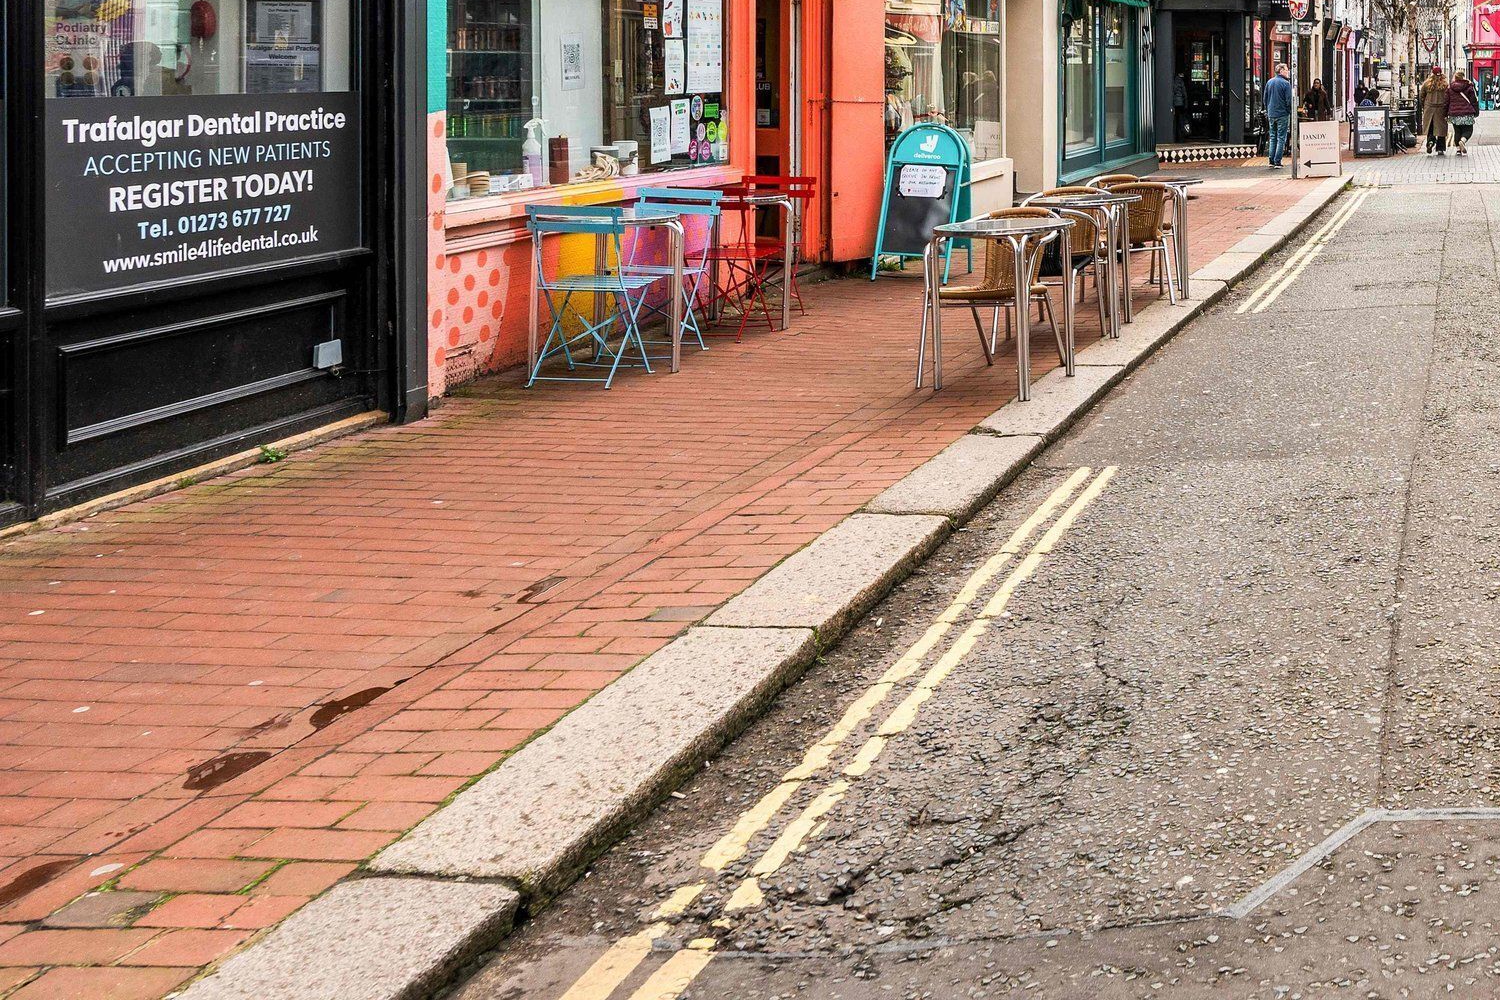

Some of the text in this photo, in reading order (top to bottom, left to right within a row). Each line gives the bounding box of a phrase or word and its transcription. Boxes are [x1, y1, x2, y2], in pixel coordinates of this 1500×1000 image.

[55, 22, 107, 35] Podiatry
[62, 107, 346, 147] Trafalgar Dental Practice
[1302, 133, 1327, 141] DANDY
[83, 140, 331, 176] ACCEPTING NEW PATIENTS
[913, 152, 941, 160] deliveroo
[109, 169, 314, 212] REGISTER TODAY!
[137, 204, 292, 240] Tel. 01273 677 727
[103, 225, 319, 274] www.smile4lifedental.co.uk
